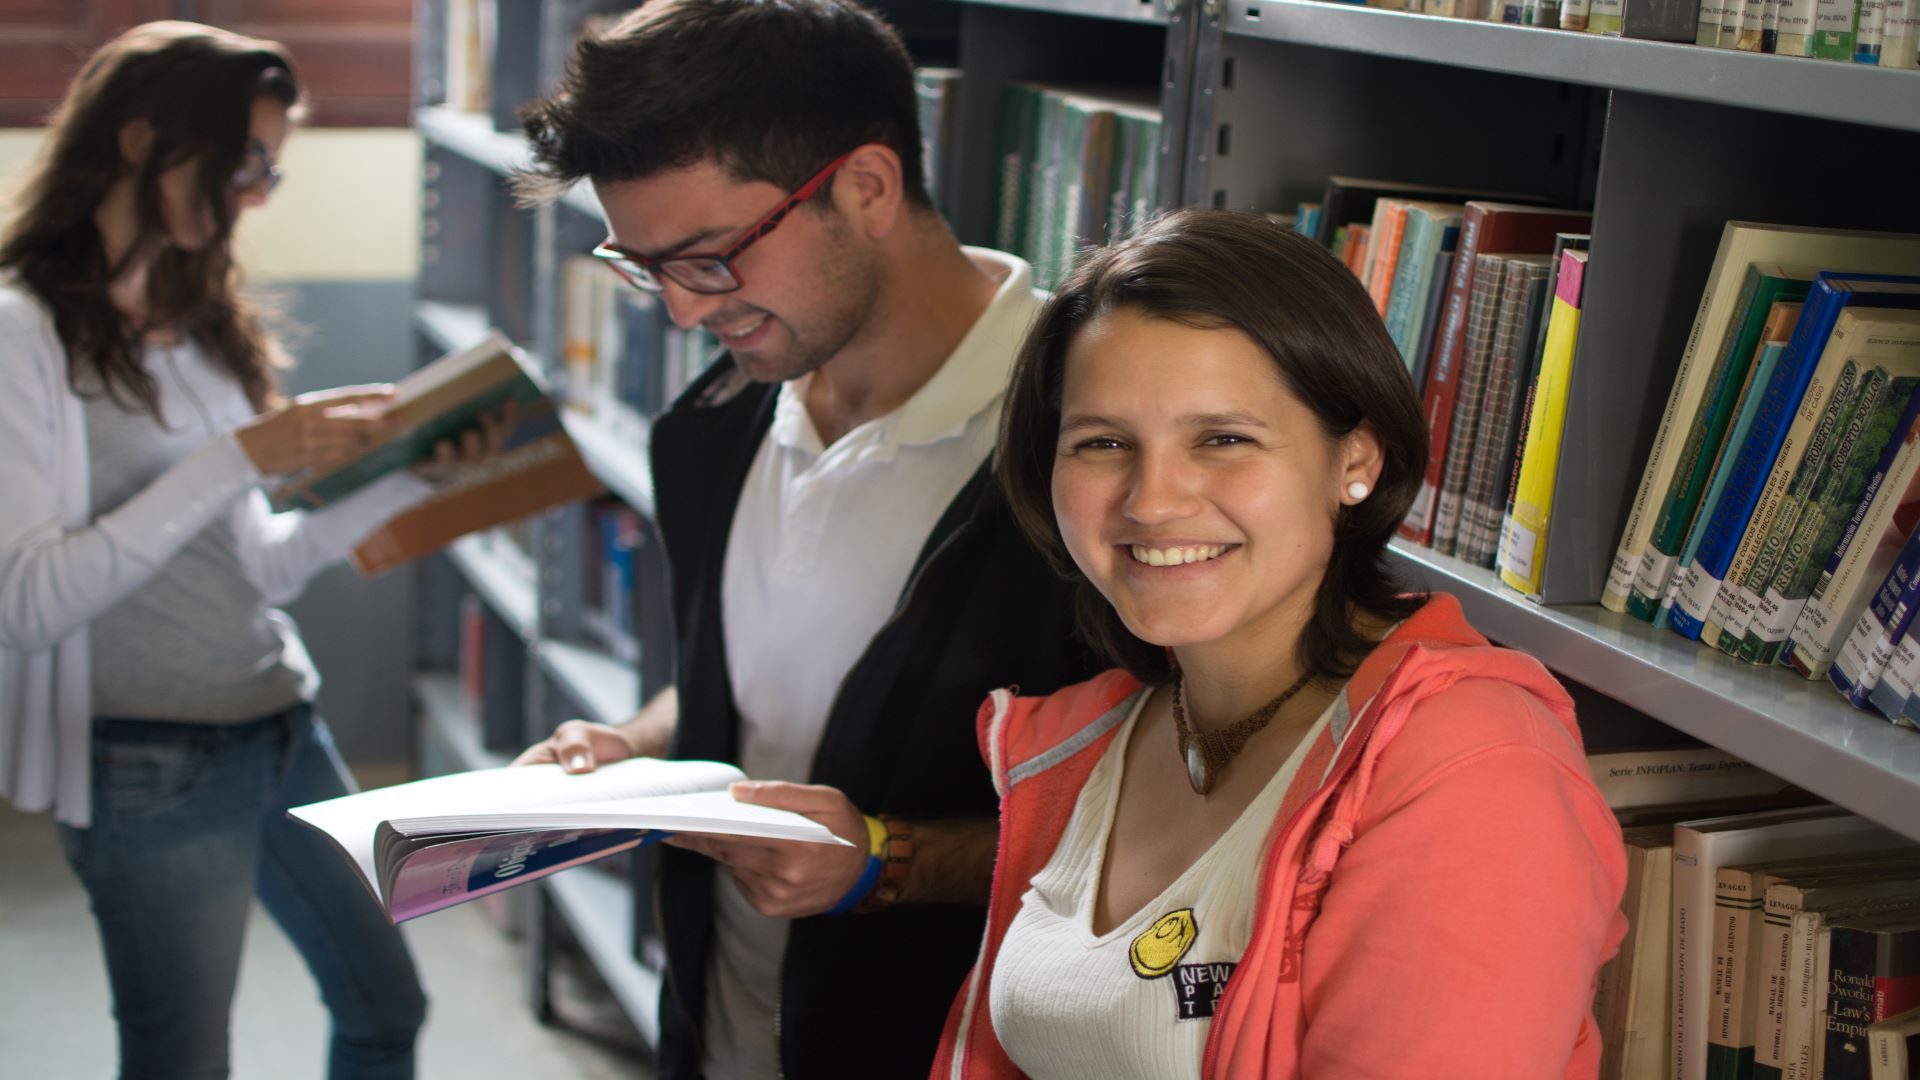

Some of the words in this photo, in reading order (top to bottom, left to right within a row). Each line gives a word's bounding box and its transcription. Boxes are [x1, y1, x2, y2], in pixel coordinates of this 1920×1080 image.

[1807, 415, 1834, 464] ROBERTO
[1828, 369, 1854, 416] BOULLON
[1832, 421, 1860, 471] ROBERTO
[1855, 374, 1882, 423] BOULLON
[1733, 558, 1742, 569] DE
[1738, 525, 1756, 557] COSTOS
[1752, 475, 1777, 525] MARGINALES
[1745, 553, 1754, 565] DE
[1750, 499, 1777, 553] ELECTRICIDAD
[1776, 469, 1790, 491] AGUA
[1747, 535, 1782, 590] URISMO
[1610, 768, 1633, 777] Serie
[1688, 762, 1716, 772] Temas
[1779, 932, 1789, 971] ARGENTINO
[1181, 965, 1229, 984] NEW
[1721, 1008, 1729, 1038] HISTORIA
[1727, 916, 1735, 953] ARGENTINO
[1834, 969, 1874, 988] Ronald
[1185, 985, 1195, 998] P
[1768, 988, 1776, 1015] MANUAL
[1776, 975, 1785, 1006] DERECHO
[1184, 1001, 1194, 1014] T
[1834, 1000, 1870, 1021] Law's
[1827, 1016, 1868, 1038] Empir
